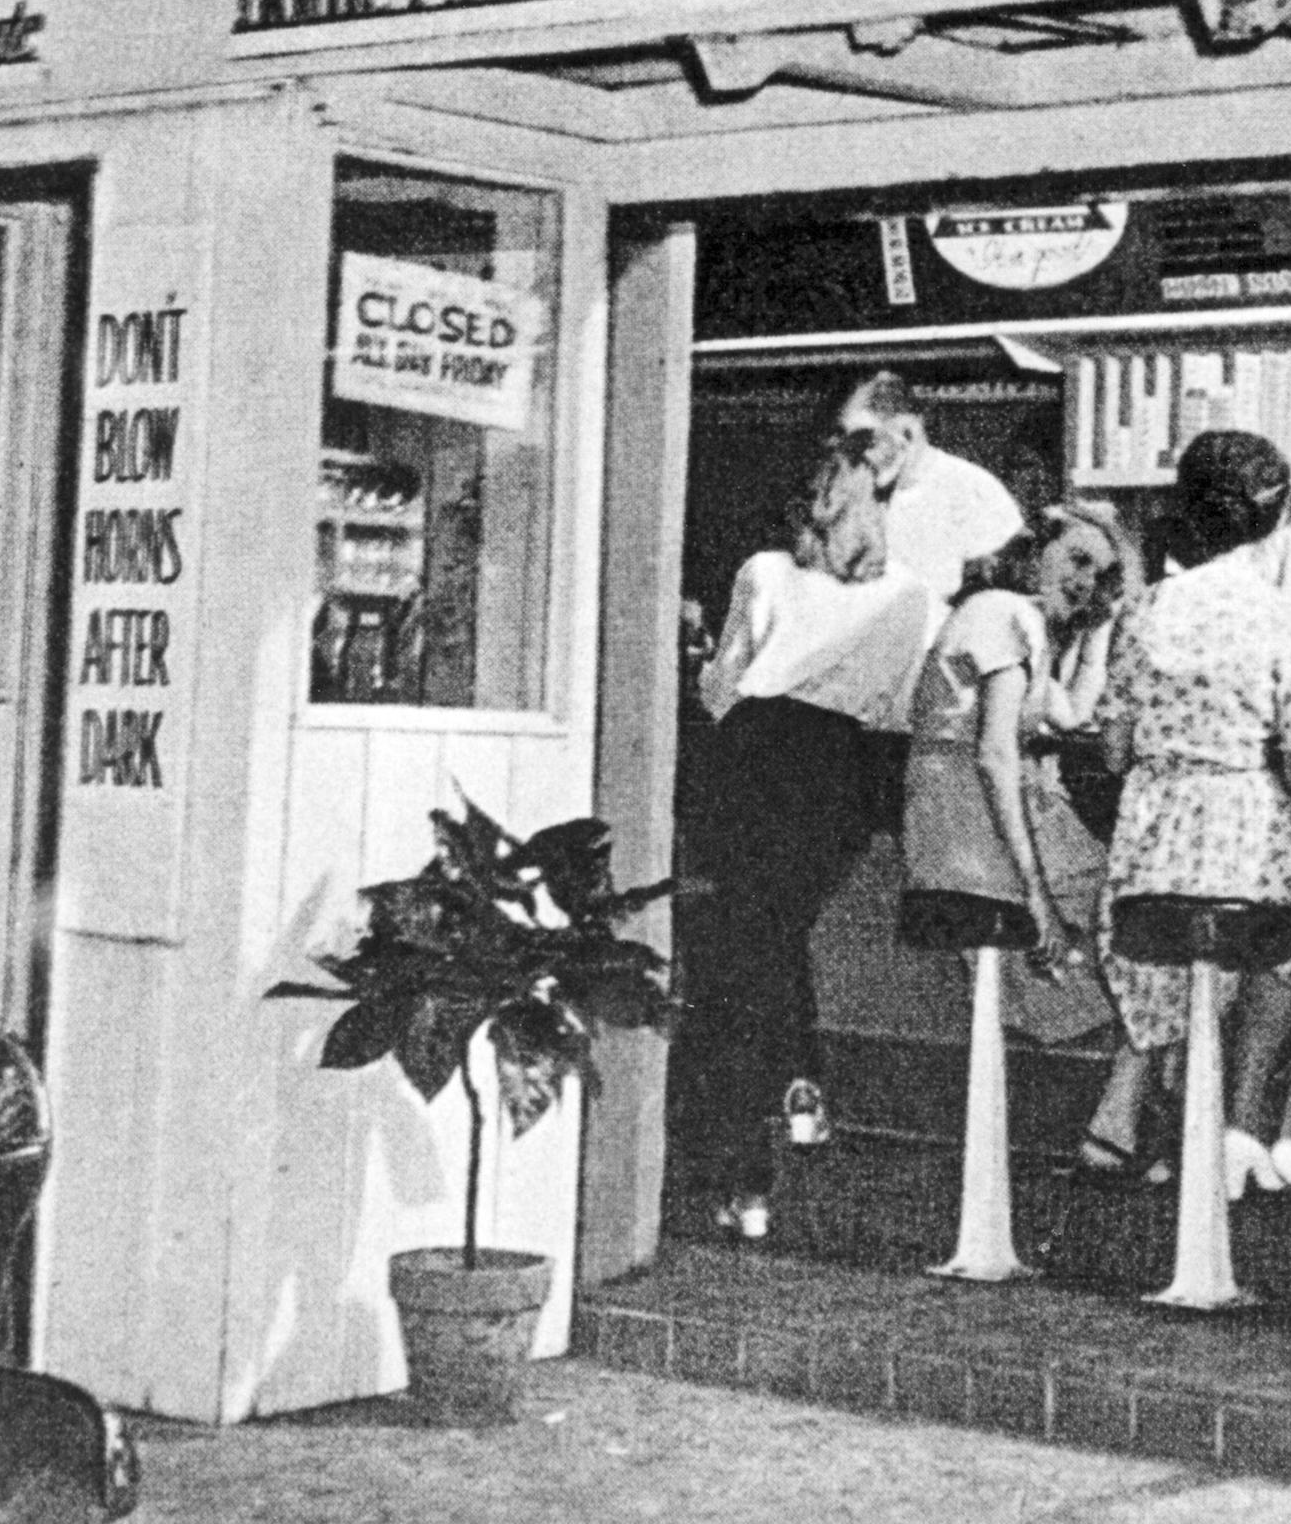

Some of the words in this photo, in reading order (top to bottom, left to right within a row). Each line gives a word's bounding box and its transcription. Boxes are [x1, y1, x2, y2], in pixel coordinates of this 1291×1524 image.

[1002, 213, 1085, 233] CREAM
[357, 290, 516, 349] CLOSED
[94, 406, 181, 484] BLOW
[84, 507, 183, 585] HORNS
[79, 607, 171, 687] AFTER
[79, 708, 165, 790] DARK
